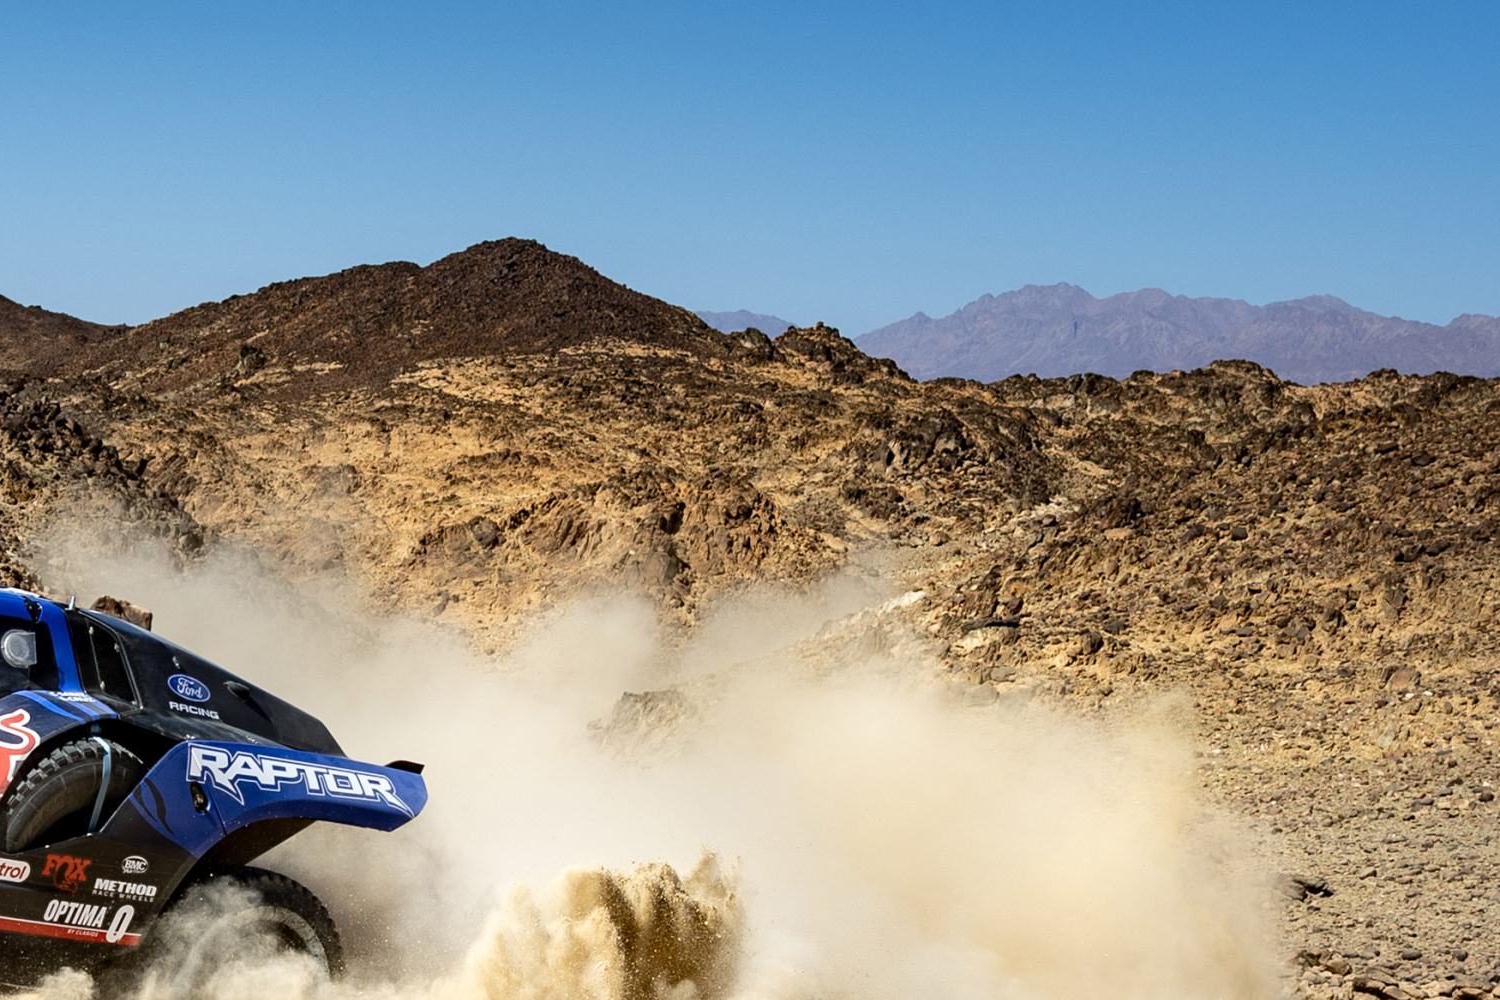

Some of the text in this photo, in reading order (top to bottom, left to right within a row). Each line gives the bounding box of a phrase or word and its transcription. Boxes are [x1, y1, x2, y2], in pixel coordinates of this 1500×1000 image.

[177, 677, 203, 699] Ford
[169, 701, 220, 720] RACING
[187, 743, 414, 818] RAPTOR
[42, 854, 91, 884] FOX
[124, 860, 147, 871] BMC
[92, 889, 155, 903] RACE WHEELS
[94, 878, 158, 897] METHOD
[43, 899, 107, 928] OPTIMA
